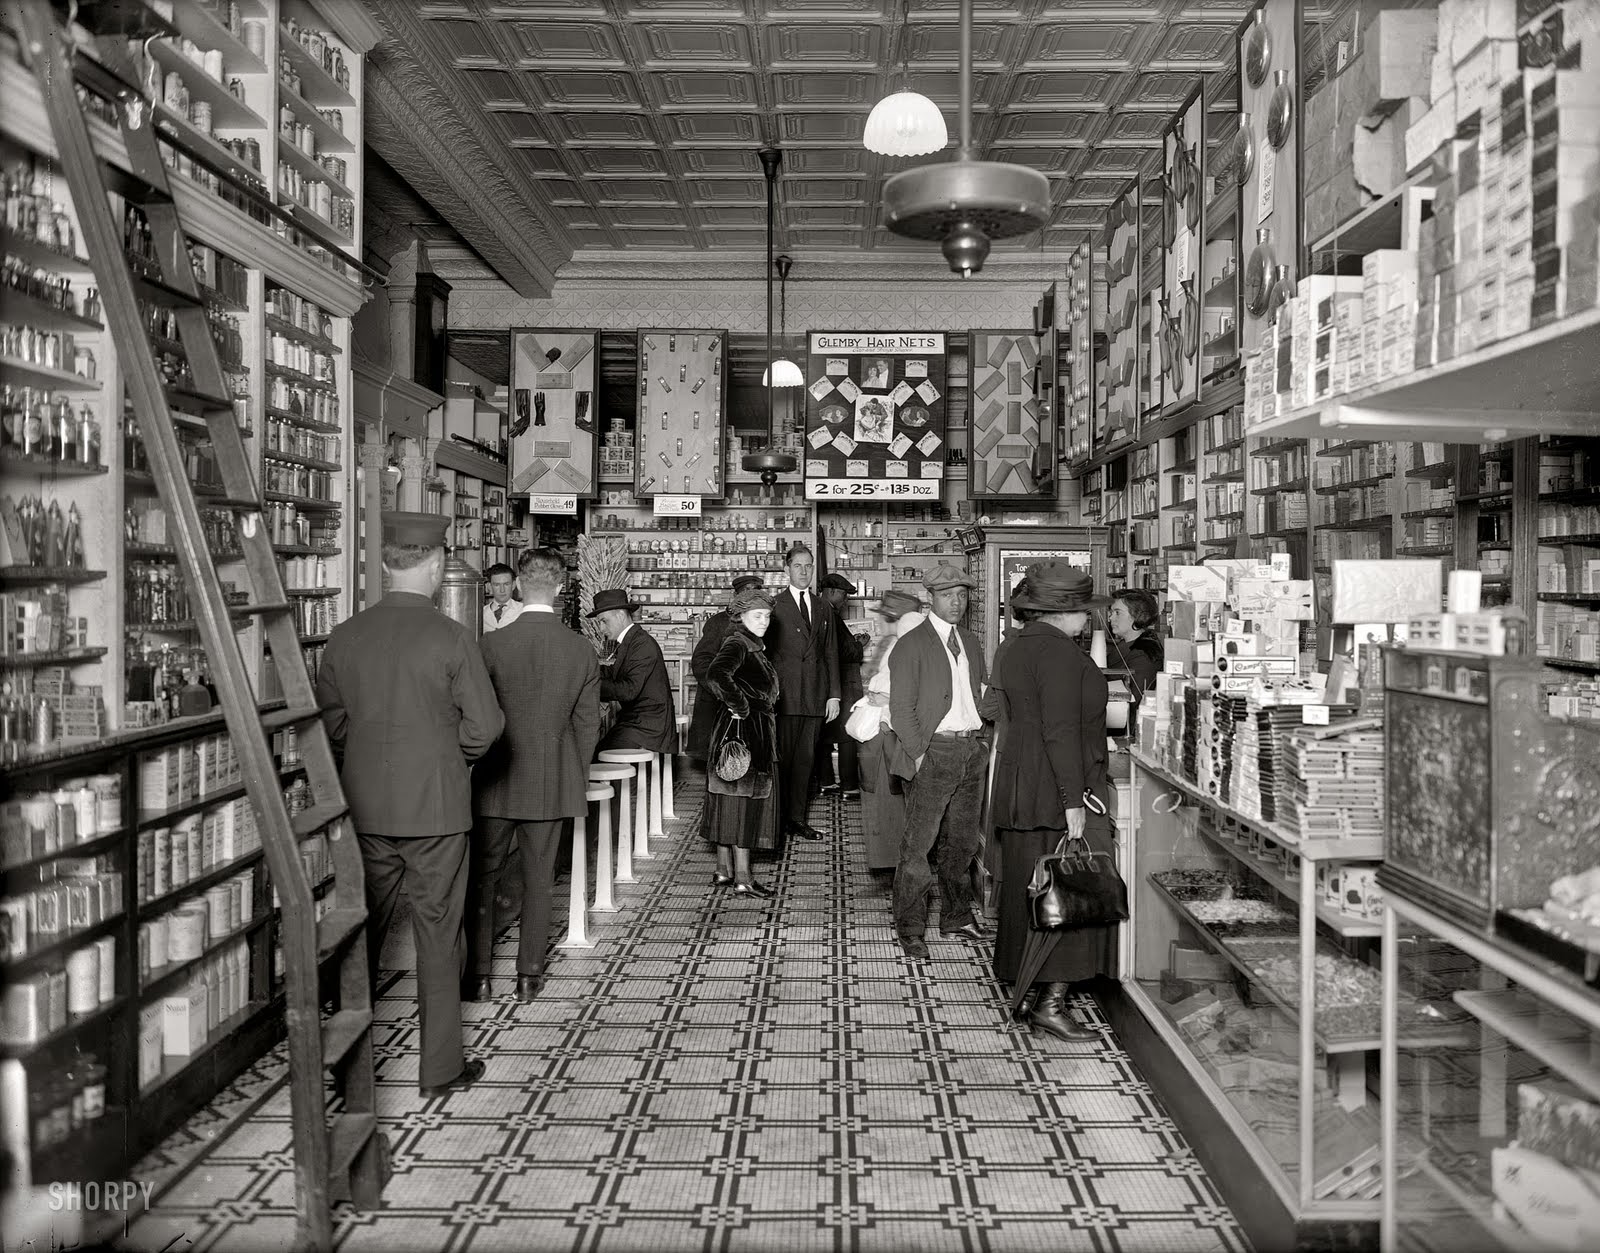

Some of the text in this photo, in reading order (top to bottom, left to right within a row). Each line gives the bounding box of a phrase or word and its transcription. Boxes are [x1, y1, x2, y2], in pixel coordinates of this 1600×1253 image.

[818, 336, 936, 348] GLEMBY HAIR NETS
[815, 483, 829, 494] 2
[832, 484, 847, 494] for
